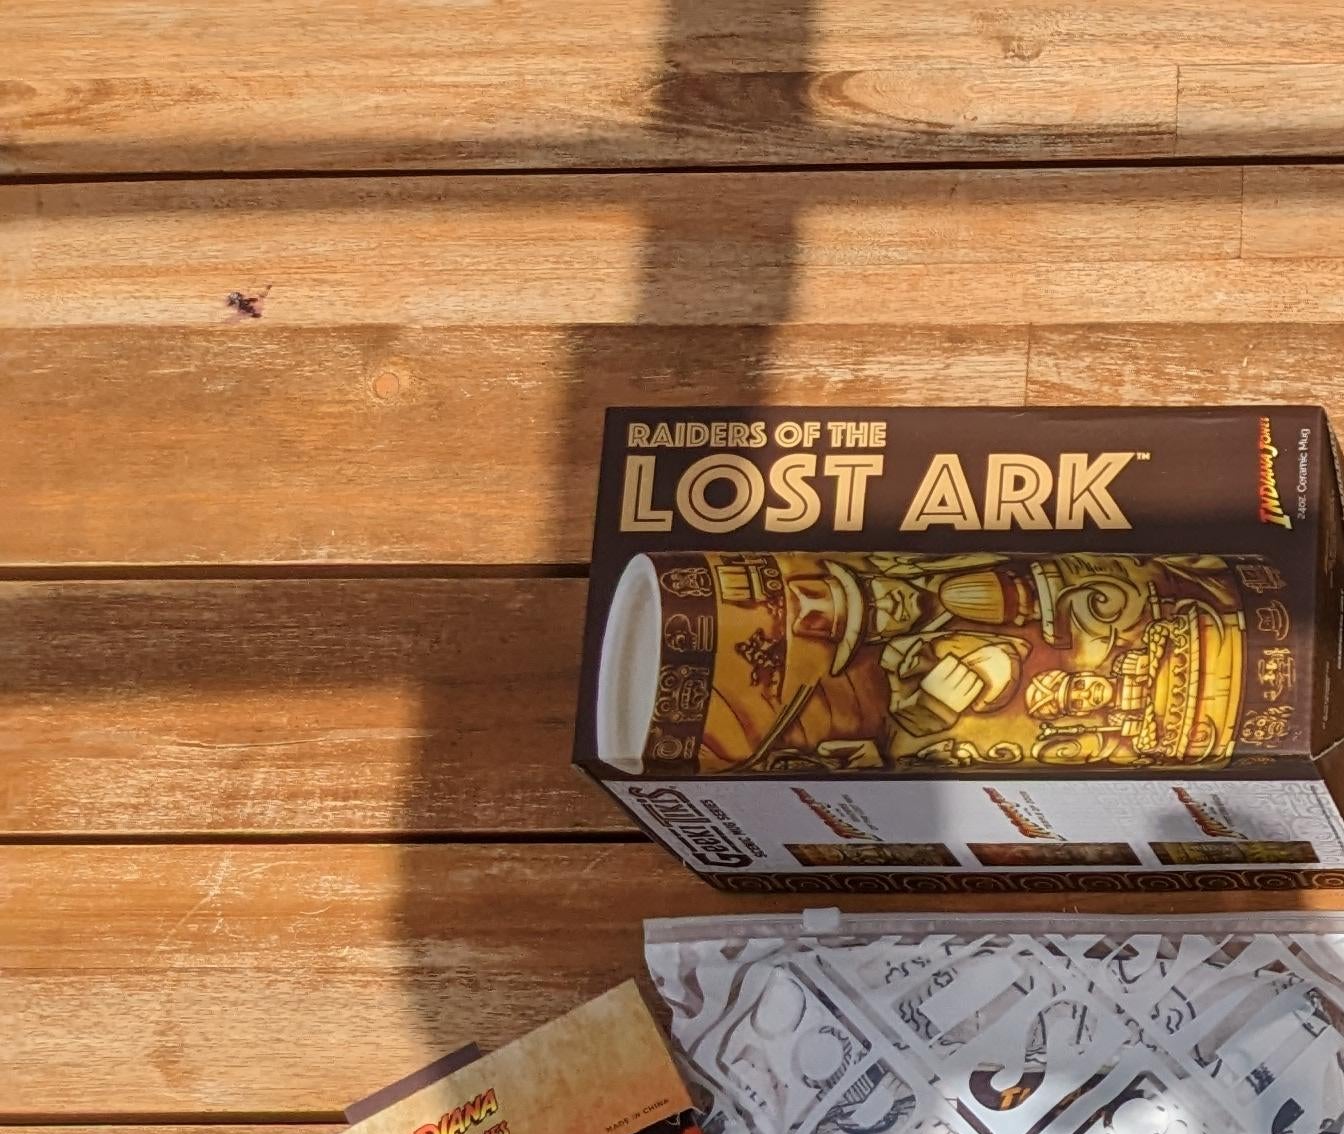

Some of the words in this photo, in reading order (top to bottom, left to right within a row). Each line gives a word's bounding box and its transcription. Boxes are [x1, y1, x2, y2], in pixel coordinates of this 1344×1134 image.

[628, 422, 766, 448] RAIDERS
[776, 422, 822, 448] OF
[827, 422, 887, 448] THE
[1297, 428, 1311, 451] Mug
[1296, 452, 1308, 493] Ceramic
[620, 453, 884, 532] LOST
[1258, 453, 1293, 530] INDIANA
[605, 1117, 629, 1133] MADE
[642, 1099, 669, 1115] CHINA
